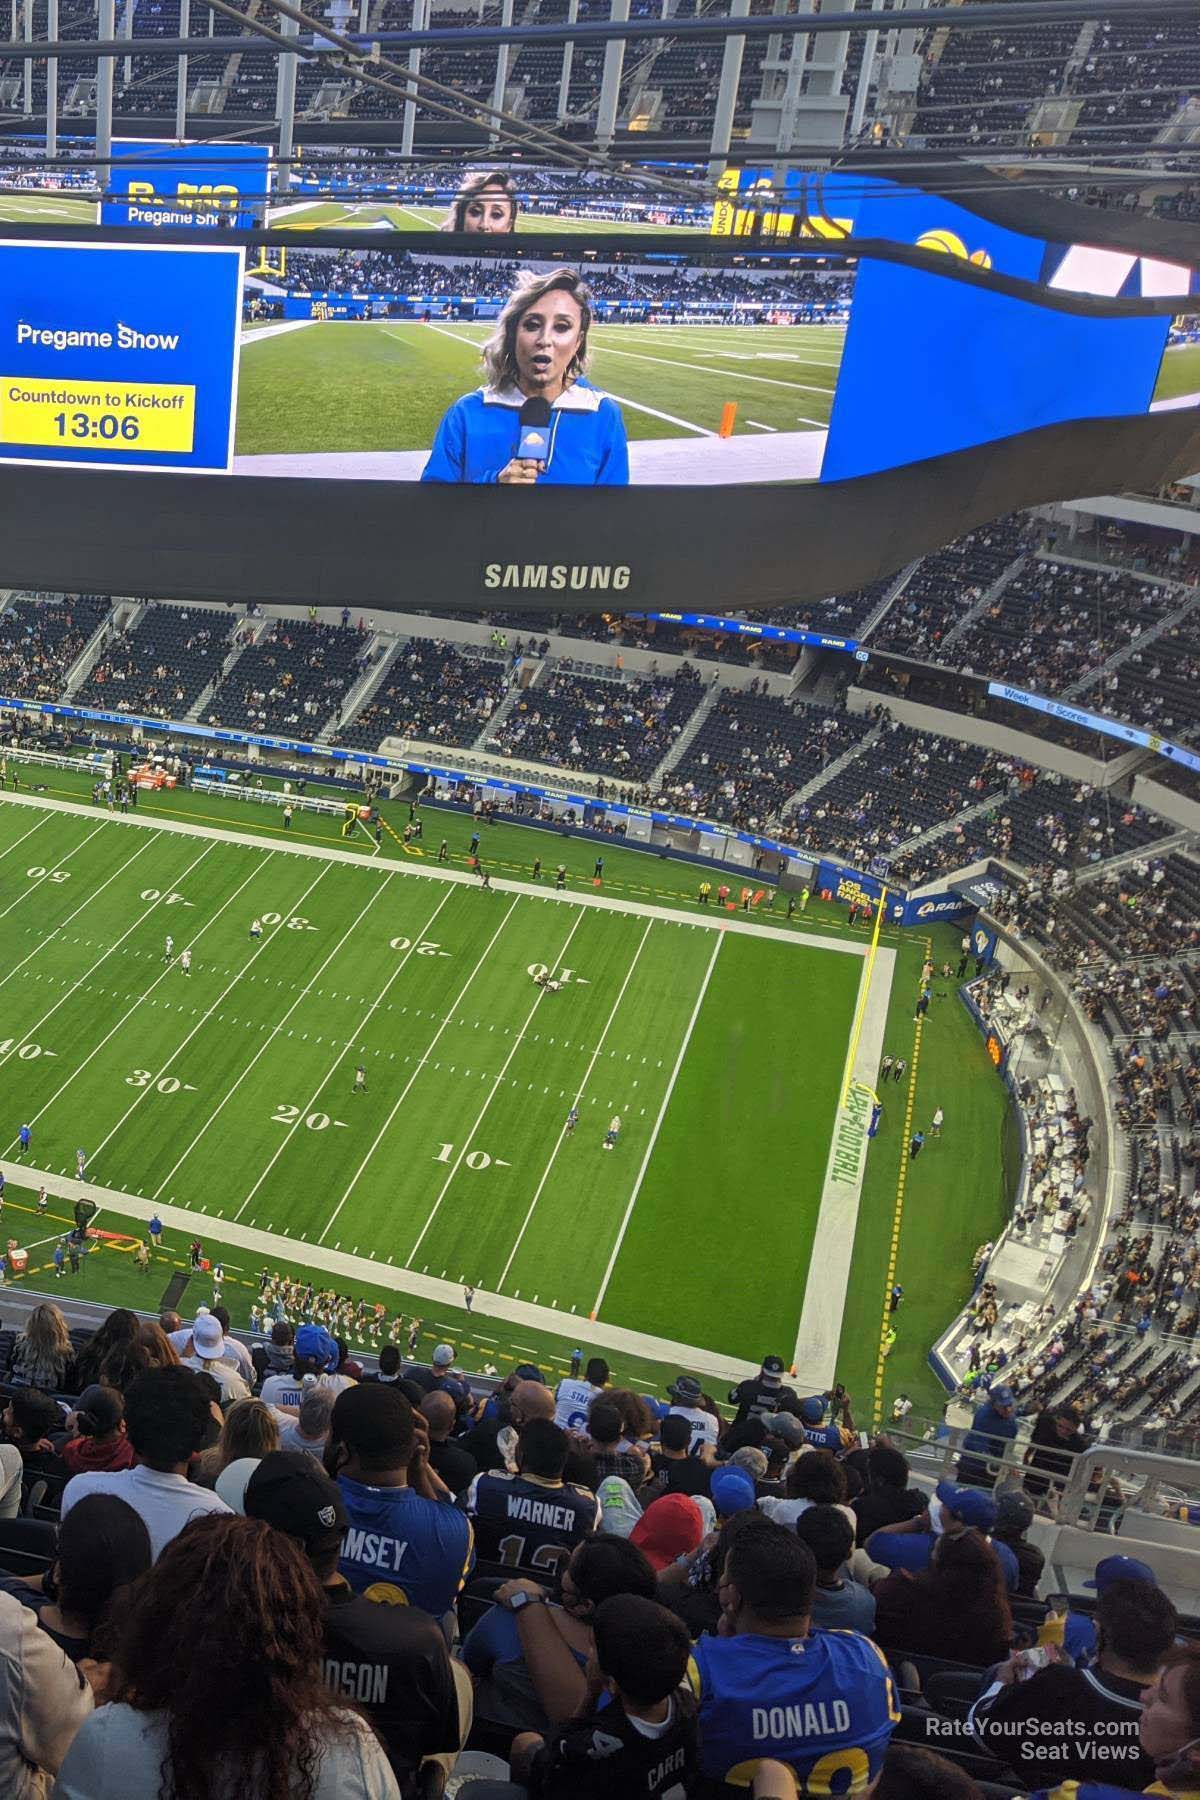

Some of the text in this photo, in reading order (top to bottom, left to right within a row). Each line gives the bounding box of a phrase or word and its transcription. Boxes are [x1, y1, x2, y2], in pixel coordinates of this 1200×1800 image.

[128, 208, 193, 225] Pregame
[17, 324, 179, 350] Pregame Show
[8, 387, 185, 409] Countdown to Kickoff
[54, 412, 140, 440] 13:06
[483, 562, 632, 591] SAMSUNG
[739, 625, 763, 633] RAMS
[822, 638, 846, 647] RAMS
[1004, 688, 1089, 724] Week Scores
[464, 775, 488, 784] RAMS
[544, 791, 568, 800] RAMS
[627, 808, 652, 817] RAMS
[713, 826, 738, 838] RAMS
[797, 852, 821, 864] RAMS
[26, 866, 71, 884] 50
[839, 878, 861, 891] LOS
[139, 888, 186, 906] 40
[259, 912, 311, 931] 30
[389, 937, 443, 957] 20
[528, 963, 577, 983] 10
[125, 1069, 183, 1094] 30
[270, 1104, 332, 1131] 20
[432, 1143, 490, 1171] 10
[831, 1116, 865, 1185] FOOTBALL
[507, 1494, 576, 1532] WARNER
[319, 1658, 389, 1703] DSON
[752, 1700, 850, 1740] DONALD
[648, 1748, 685, 1791] CARR
